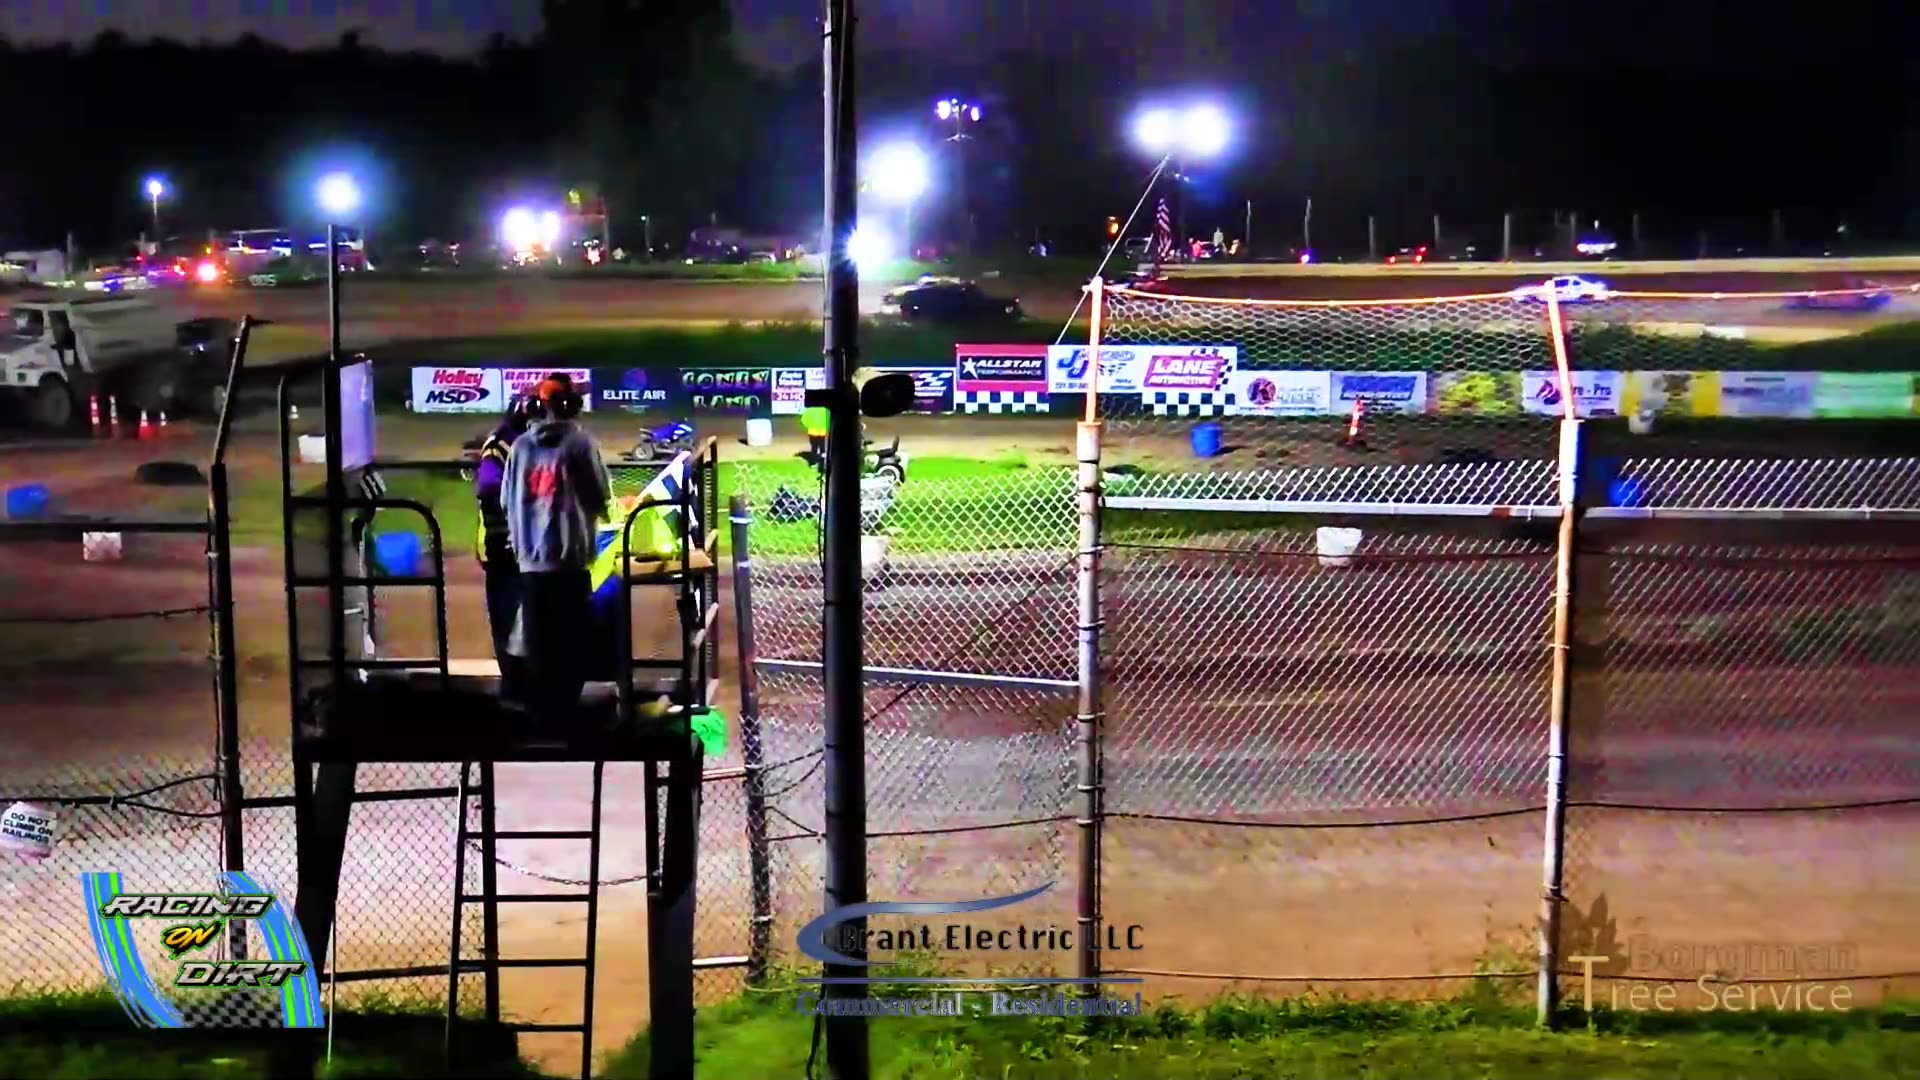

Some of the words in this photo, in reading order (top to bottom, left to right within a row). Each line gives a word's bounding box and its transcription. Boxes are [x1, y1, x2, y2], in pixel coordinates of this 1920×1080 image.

[976, 359, 1042, 368] ALLSTAR
[1153, 358, 1217, 374] LANE
[432, 369, 484, 386] Holley
[682, 371, 769, 389] CONEY
[1148, 375, 1212, 385] AUTOMOTIVE
[603, 390, 640, 400] ELITE
[642, 390, 667, 400] AIR
[1594, 384, 1612, 395] Pro
[425, 390, 473, 404] MSD
[693, 395, 760, 409] LAND
[11, 812, 26, 821] DO
[28, 816, 50, 827] NOT
[3, 819, 35, 832] CLIMB
[38, 827, 53, 837] ON
